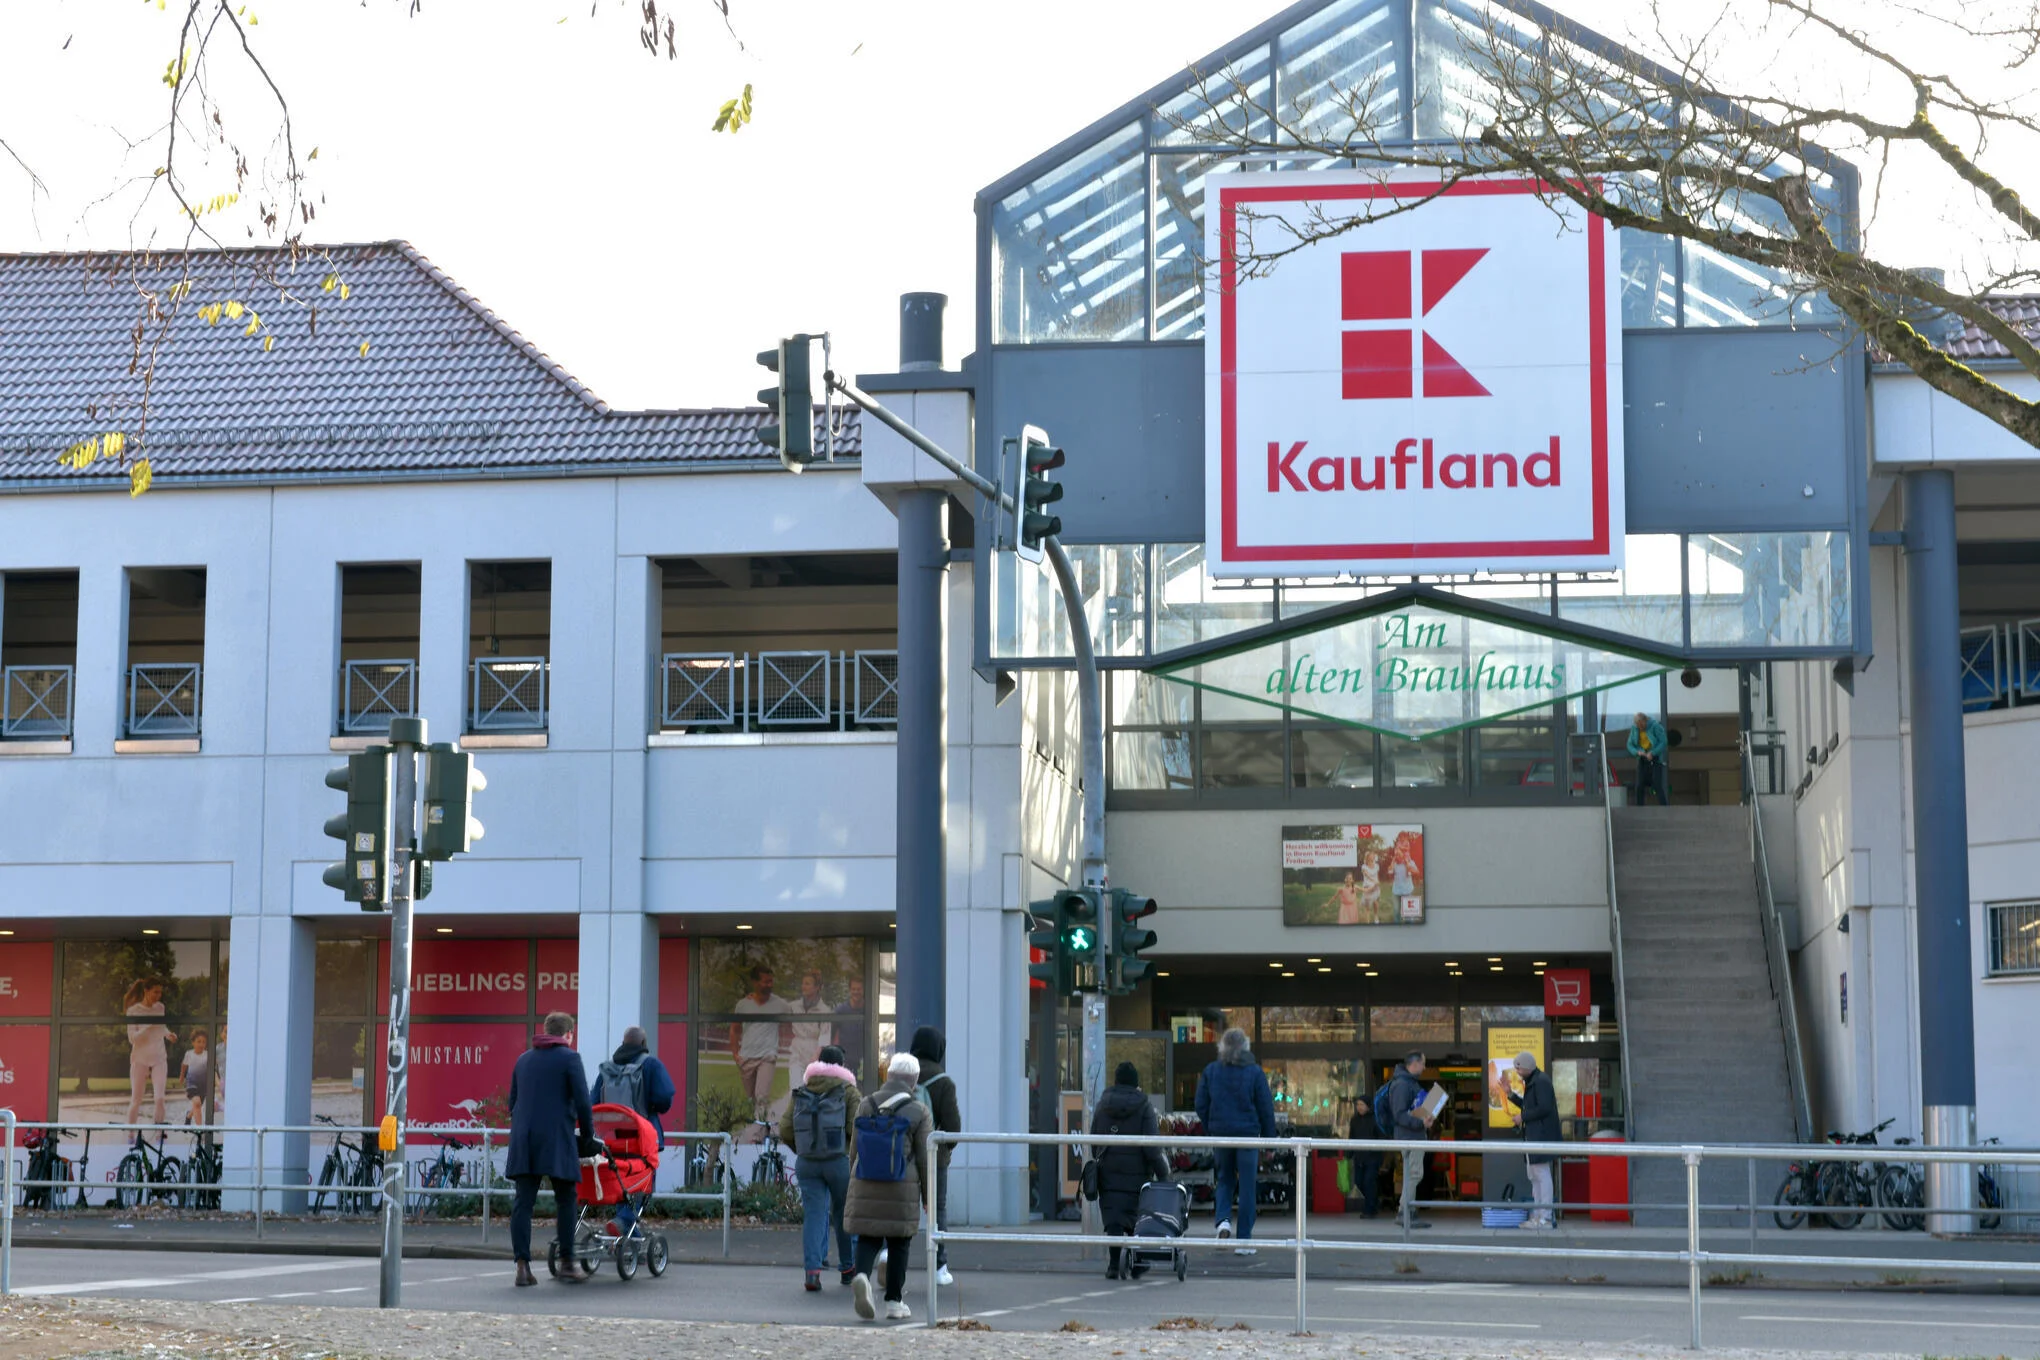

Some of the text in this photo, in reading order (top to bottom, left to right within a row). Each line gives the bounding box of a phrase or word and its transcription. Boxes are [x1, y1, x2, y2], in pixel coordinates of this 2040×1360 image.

[1267, 436, 1561, 493] Kaufland
[1378, 613, 1448, 650] Am
[1265, 650, 1565, 695] alten Brauhaus
[410, 973, 526, 992] IEBLINGS
